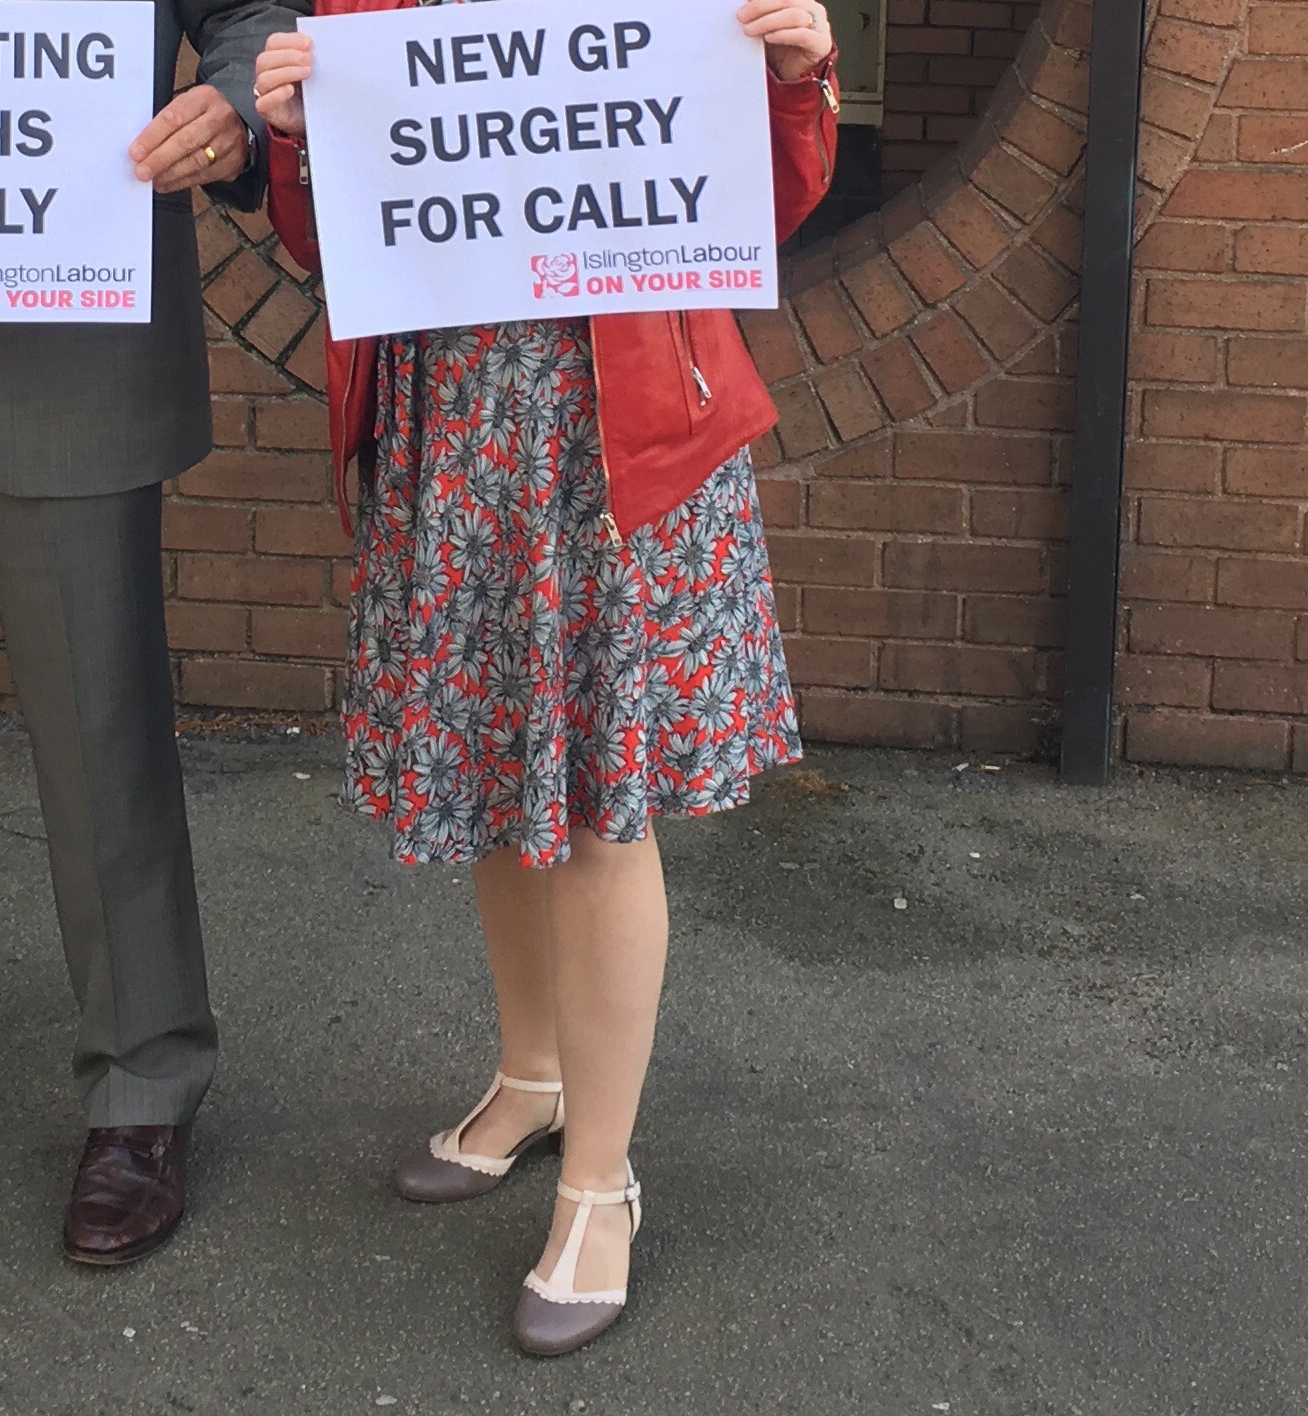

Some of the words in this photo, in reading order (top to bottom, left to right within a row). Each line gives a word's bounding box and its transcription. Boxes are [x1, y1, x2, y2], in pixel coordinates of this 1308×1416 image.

[405, 28, 546, 88] NEW
[567, 20, 652, 73] GP
[389, 95, 683, 167] SURGERY
[379, 192, 505, 248] FOR
[523, 174, 709, 235] CALLY
[582, 243, 762, 273] IslingtonLabour
[585, 275, 624, 296] ON
[630, 271, 702, 293] YOUR
[707, 269, 763, 290] SIDE
[5, 290, 74, 309] YOUR
[79, 289, 136, 309] SIDE
